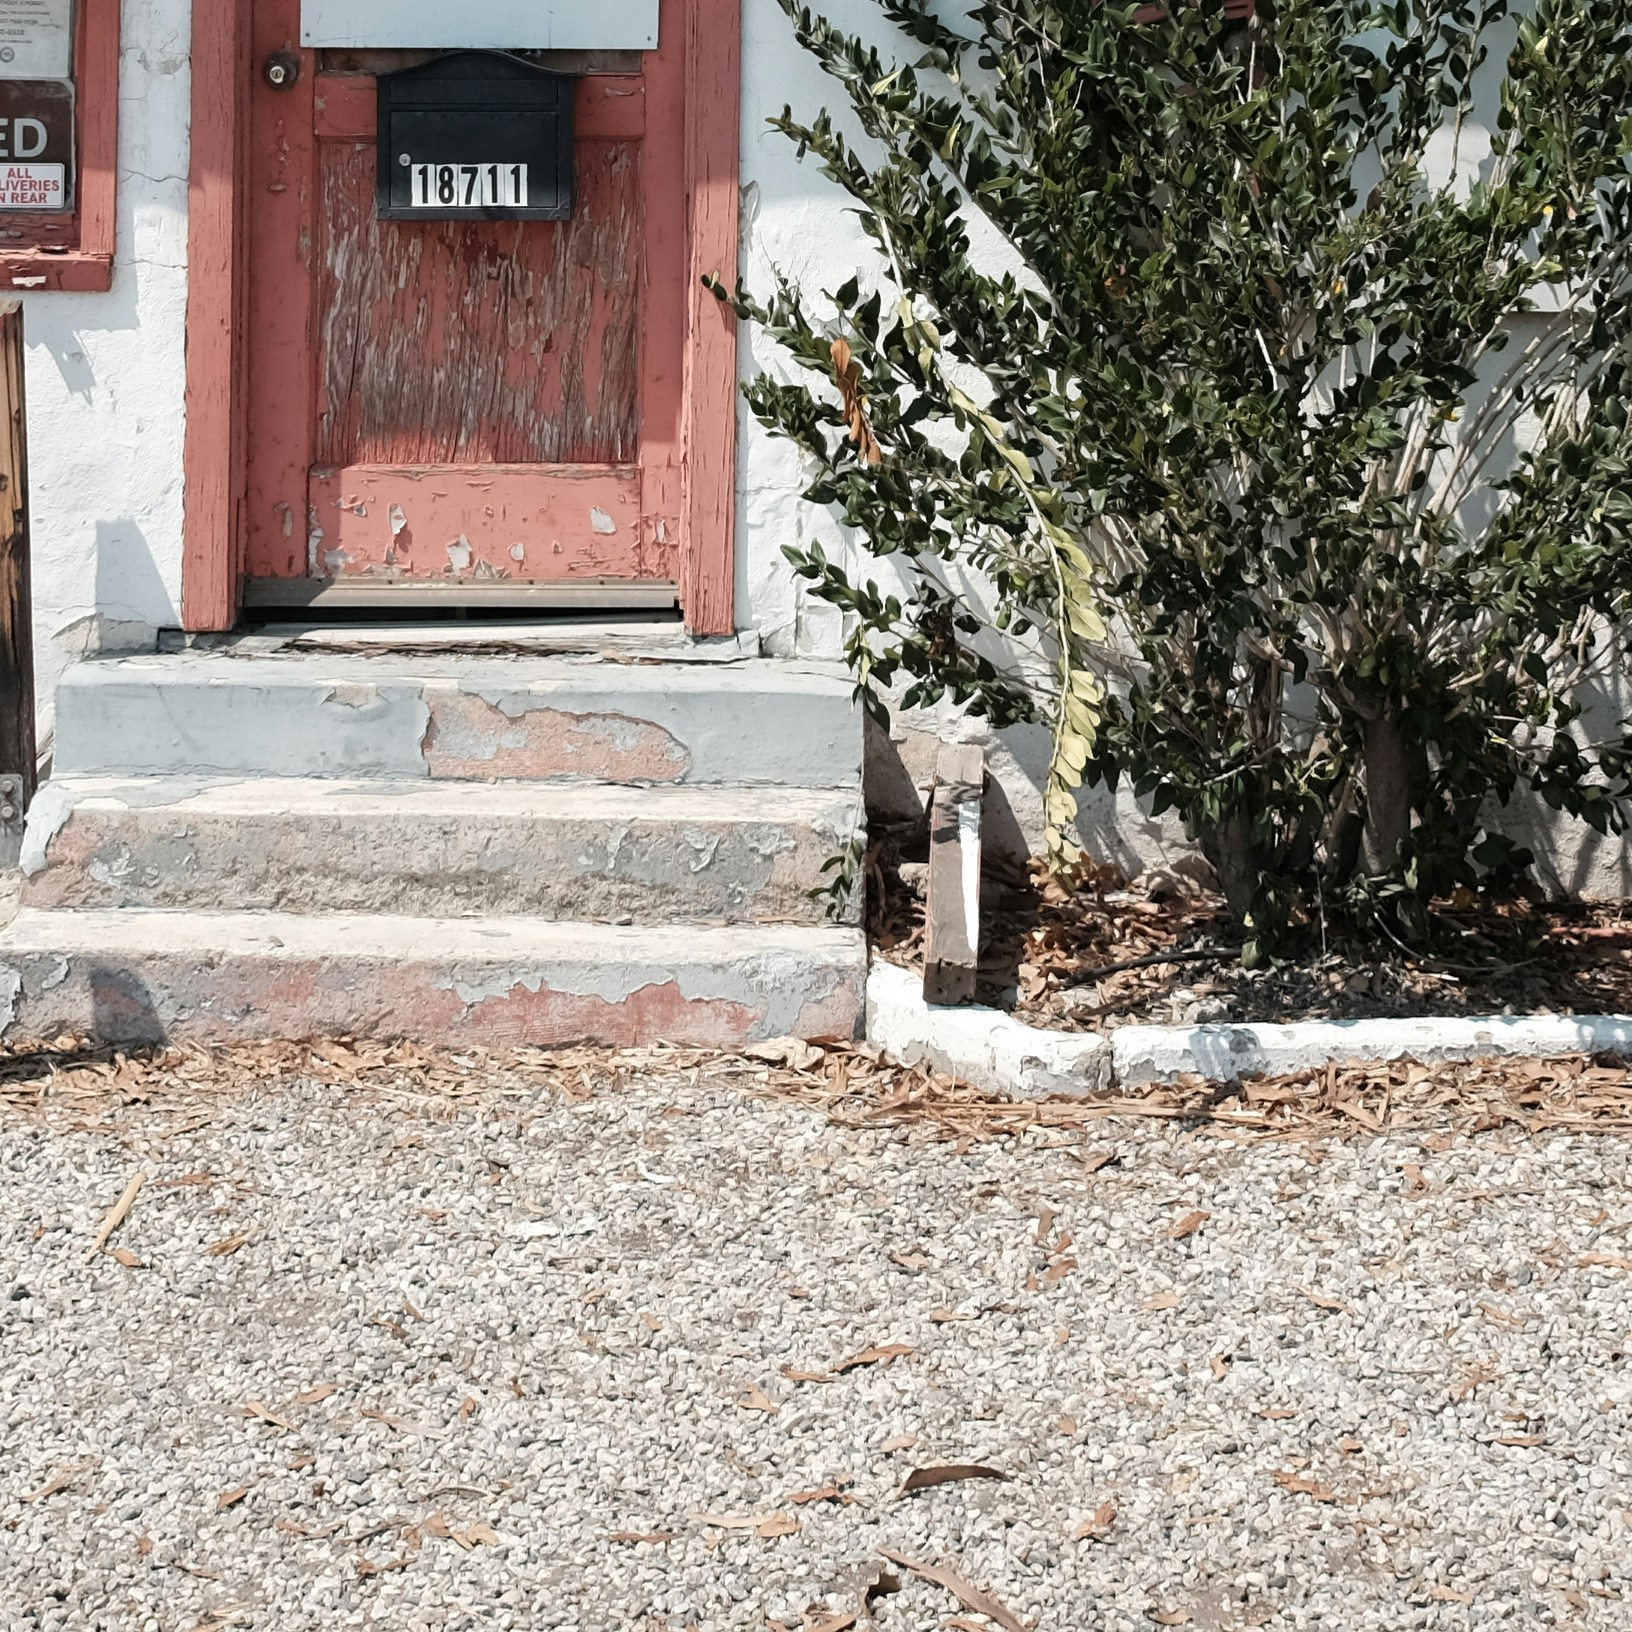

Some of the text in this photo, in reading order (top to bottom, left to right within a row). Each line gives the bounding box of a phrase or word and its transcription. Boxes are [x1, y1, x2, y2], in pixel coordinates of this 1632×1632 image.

[7, 168, 32, 179] ALL
[417, 165, 521, 205] 18711
[11, 192, 48, 204] REAR
